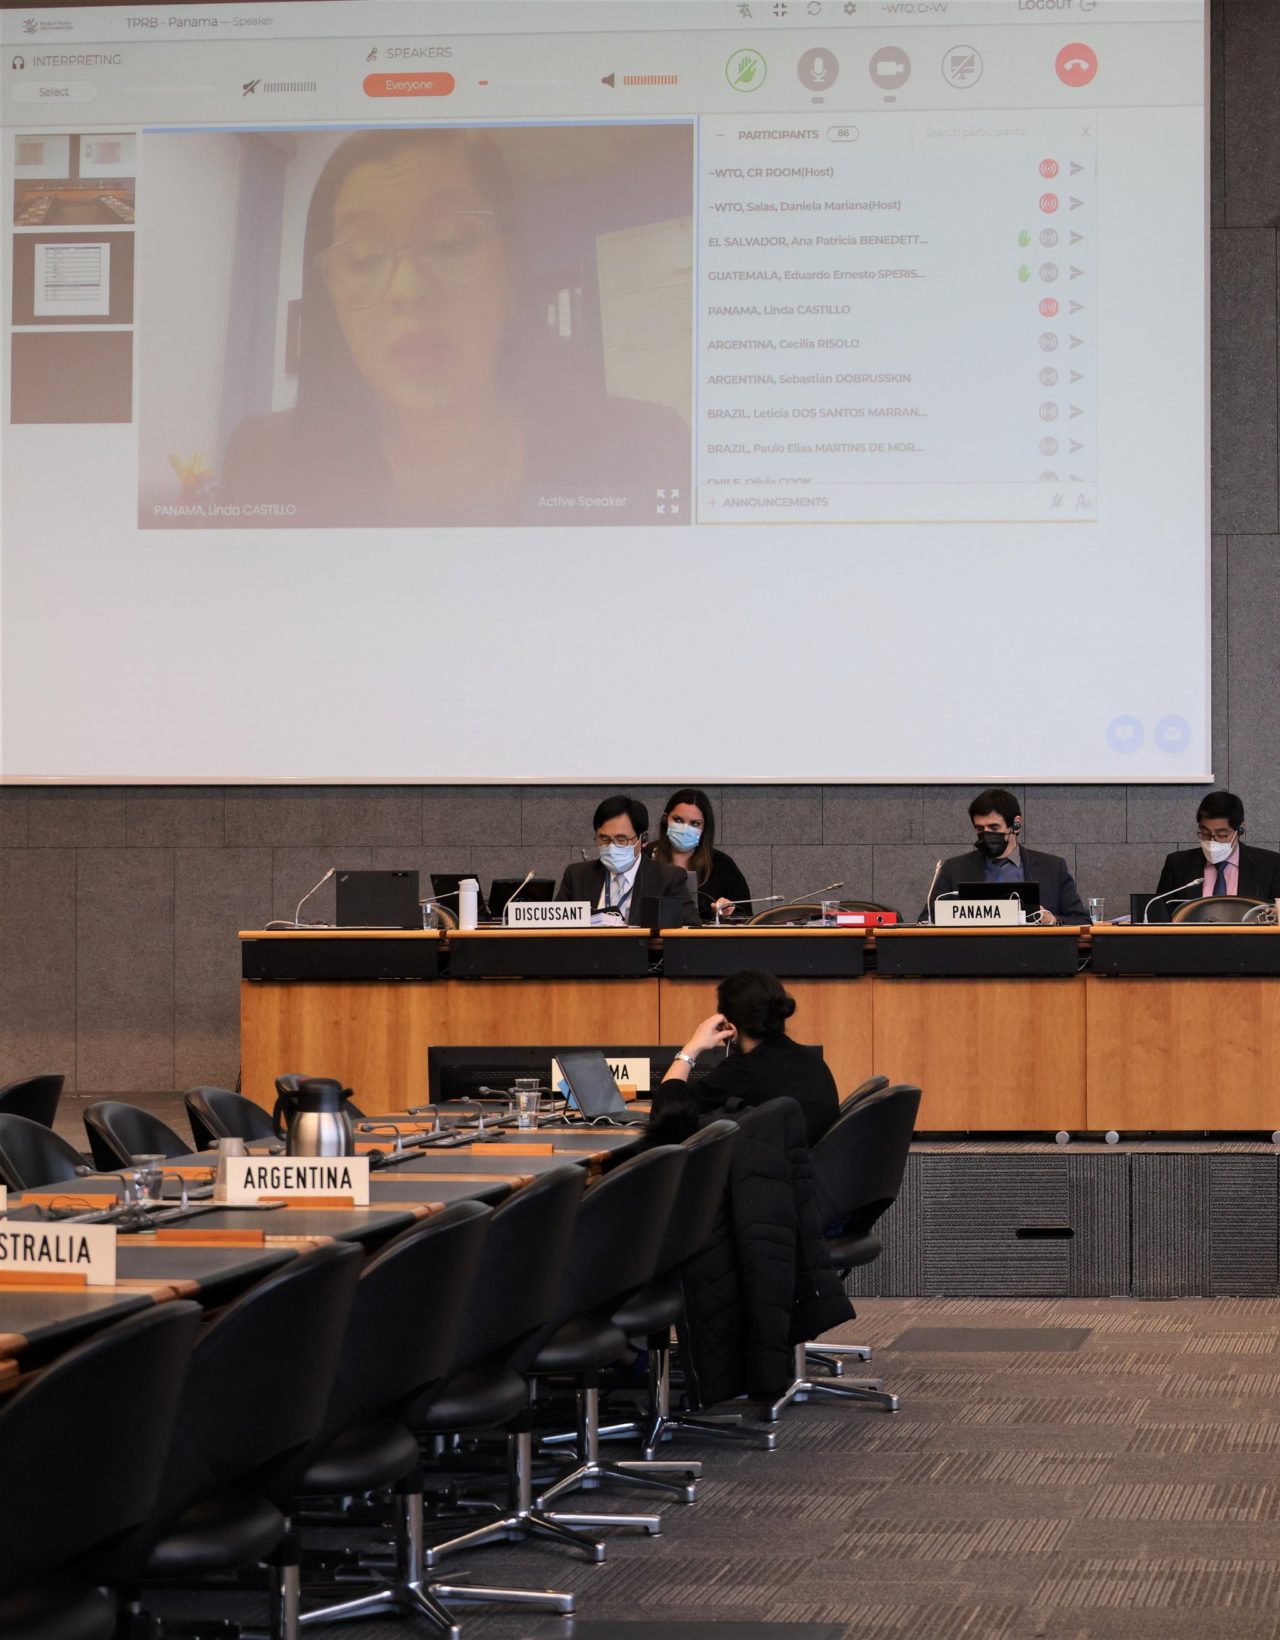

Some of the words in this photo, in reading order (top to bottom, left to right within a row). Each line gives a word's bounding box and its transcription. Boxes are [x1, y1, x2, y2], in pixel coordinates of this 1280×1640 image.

[1018, 0, 1072, 10] LOGOUT
[127, 17, 158, 28] TPRB
[169, 16, 218, 28] Panama
[233, 15, 273, 28] Speaker
[387, 46, 451, 58] SPEAKERS
[33, 53, 121, 66] INTERPRETING
[386, 79, 432, 92] Everyone
[39, 87, 69, 98] Select
[739, 129, 819, 140] PARTICIPANTS
[747, 167, 763, 178] CR
[781, 200, 821, 212] Daniela
[709, 236, 722, 248] EL
[791, 236, 812, 246] Ana
[816, 234, 856, 246] Patricia
[784, 269, 830, 281] Eduardo
[834, 269, 876, 281] Ernesto
[764, 304, 794, 316] Linda
[797, 304, 850, 315] CASTILLO
[779, 338, 815, 350] Cecilia
[818, 338, 859, 350] RISOLO
[836, 372, 911, 384] DOBRUSSKIN
[792, 408, 816, 418] DOS
[819, 407, 865, 418] SANTOS
[754, 443, 784, 454] Paulo
[787, 442, 812, 453] Elias
[816, 442, 866, 453] MARTINS
[869, 442, 884, 453] DE
[539, 495, 575, 508] Active
[579, 495, 627, 510] Speaker
[723, 496, 828, 508] ANNOUNCEMENTS
[209, 503, 240, 516] Linda
[243, 503, 296, 516] CASTILLO
[515, 906, 583, 921] DISCUSSANT
[952, 903, 1001, 920] PANAMA
[243, 1165, 352, 1190] ARGENTINA
